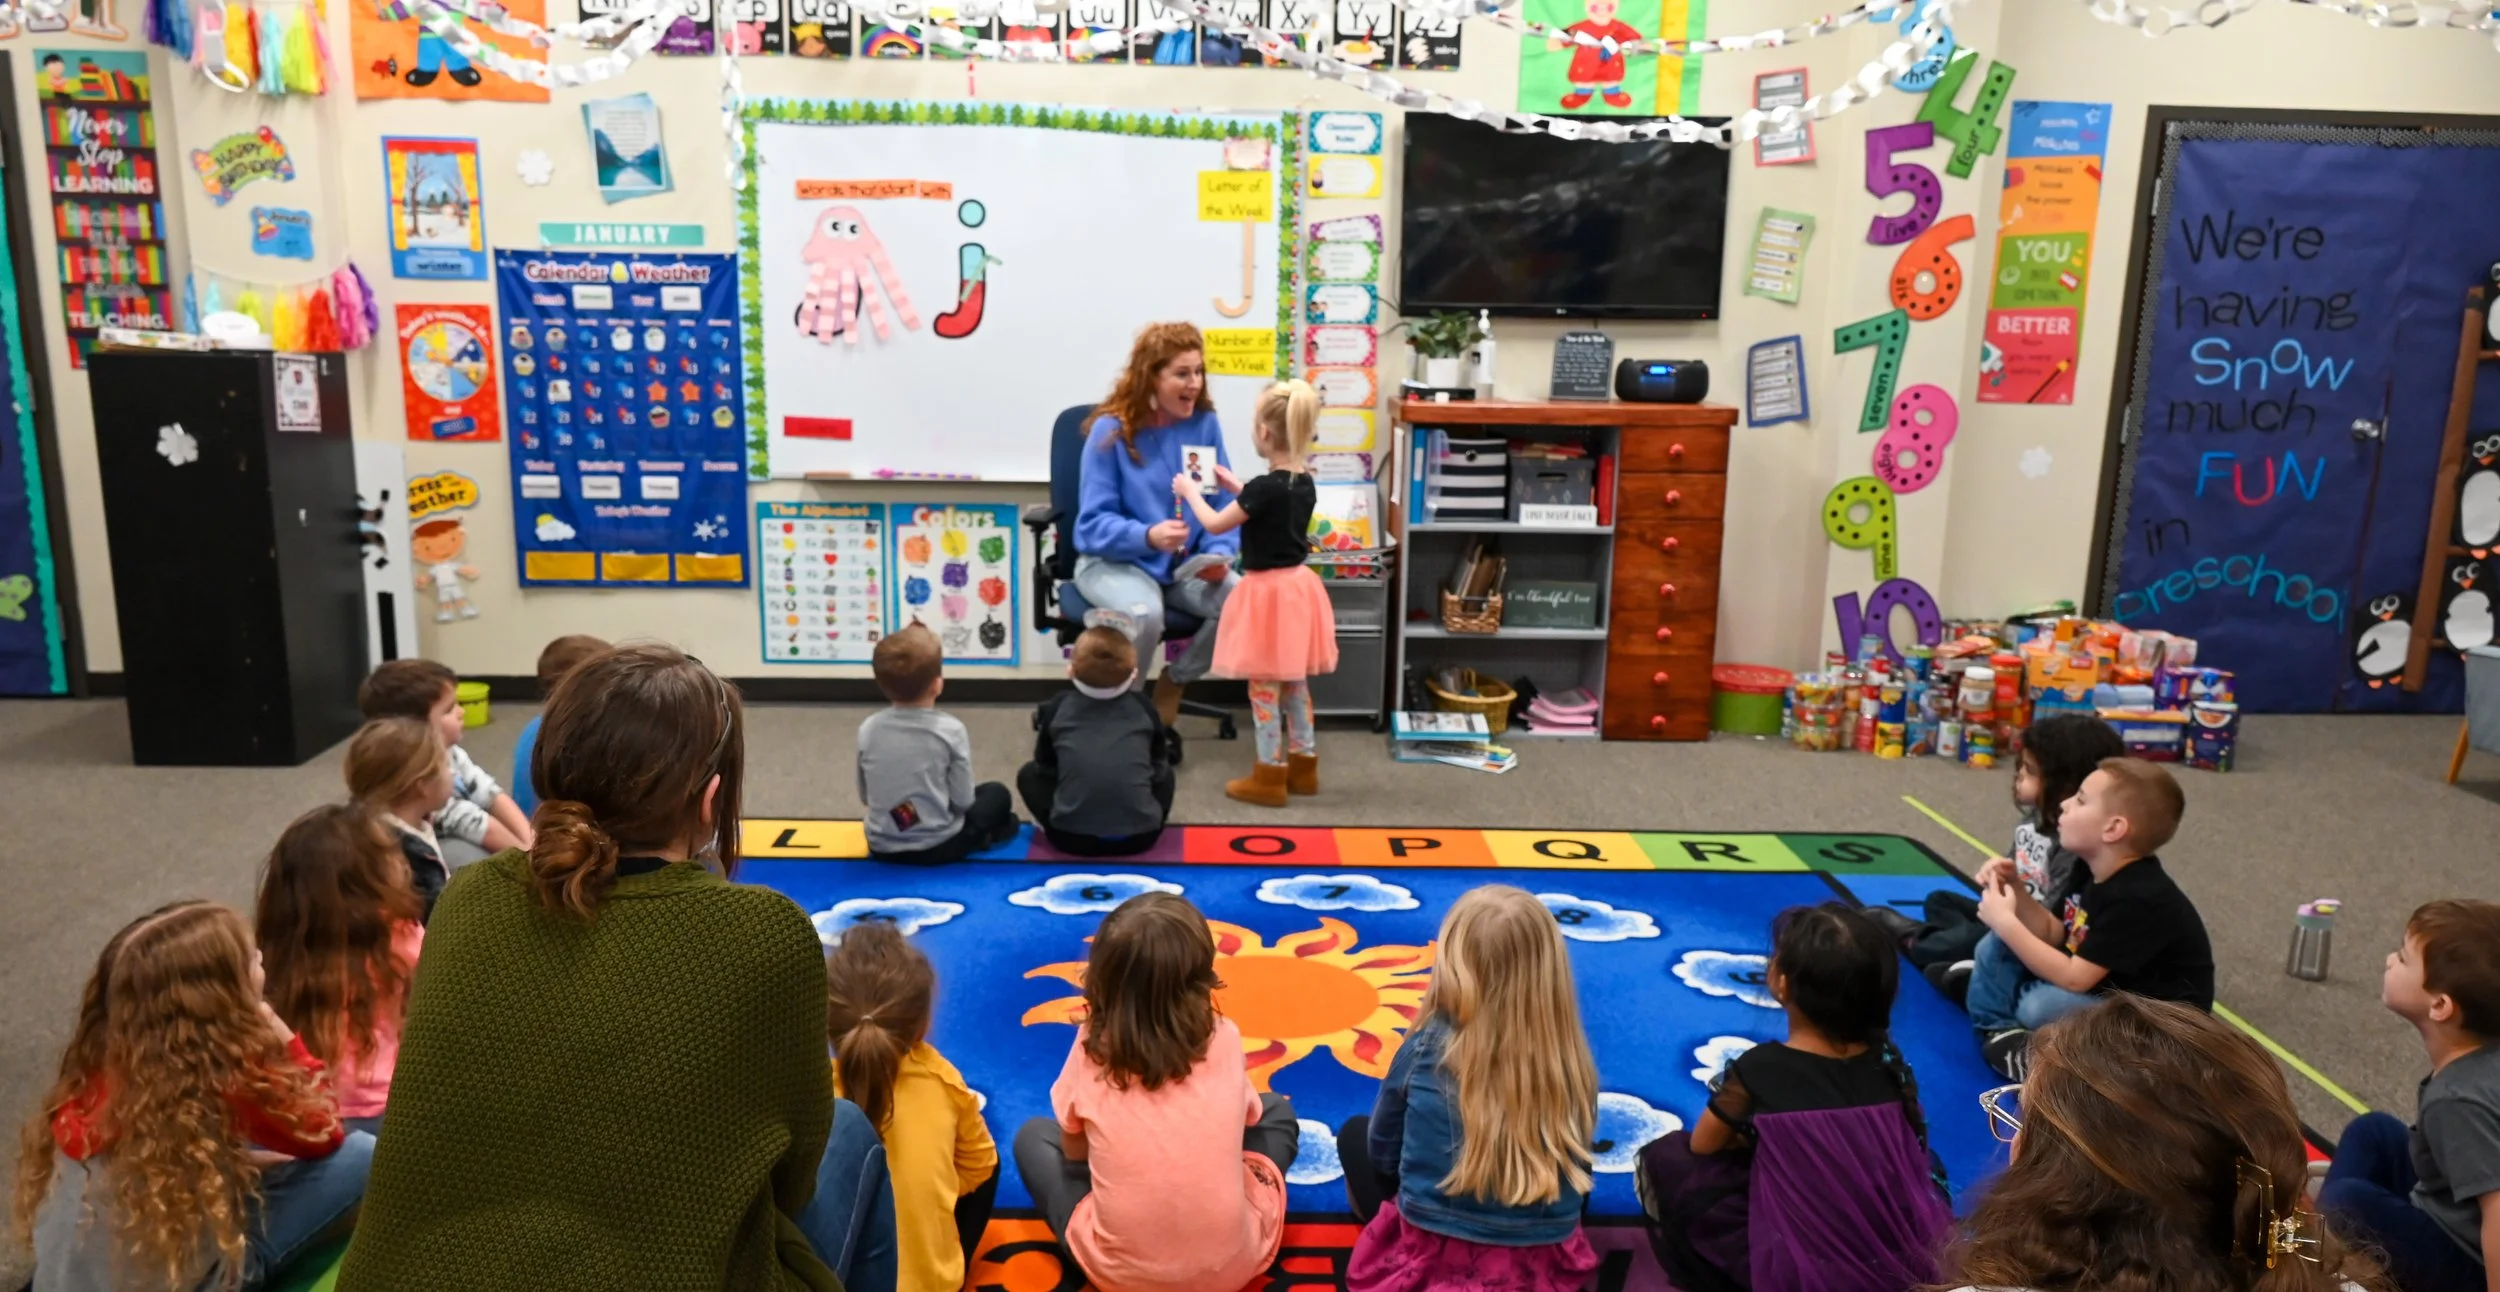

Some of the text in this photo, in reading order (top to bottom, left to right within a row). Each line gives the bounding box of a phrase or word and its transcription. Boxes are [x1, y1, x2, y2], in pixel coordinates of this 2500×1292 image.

[67, 107, 128, 139] Never
[77, 138, 124, 174] Stop
[1956, 128, 1981, 167] four
[54, 174, 154, 194] LEARNING
[1208, 178, 1263, 194] Letter of
[1864, 120, 1942, 246] 5
[1205, 202, 1264, 217] the Week
[573, 226, 671, 244] JANUARY
[1885, 219, 1918, 239] five
[2180, 208, 2325, 265] We're
[2016, 239, 2072, 263] YOU
[525, 261, 608, 282] Calendar
[630, 262, 709, 283] Weather
[1890, 214, 1975, 321] 6
[2174, 284, 2358, 332] having
[1997, 315, 2071, 336] BETTER
[1206, 331, 1273, 347] Number of
[1208, 356, 1267, 373] the Week
[1834, 307, 1910, 434] 7
[1868, 373, 1890, 423] seven
[2166, 387, 2317, 437] much
[1872, 384, 1959, 494] 8
[1877, 443, 1898, 482] eight
[408, 479, 443, 497] ress
[2195, 450, 2326, 507] FUN
[408, 490, 466, 513] eather
[913, 506, 995, 528] Colors
[1822, 475, 1898, 581] 9
[2142, 516, 2190, 557] in
[1880, 543, 1893, 575] nine
[1526, 588, 1574, 608] thankful
[2112, 553, 2346, 634] preschool
[771, 828, 821, 849] L
[1229, 835, 1297, 857] O
[1387, 837, 1442, 858] P
[1532, 839, 1609, 862] Q
[1679, 840, 1757, 864] R
[1818, 841, 1886, 864] S
[1080, 885, 1115, 901] 6
[1318, 885, 1352, 899] 7
